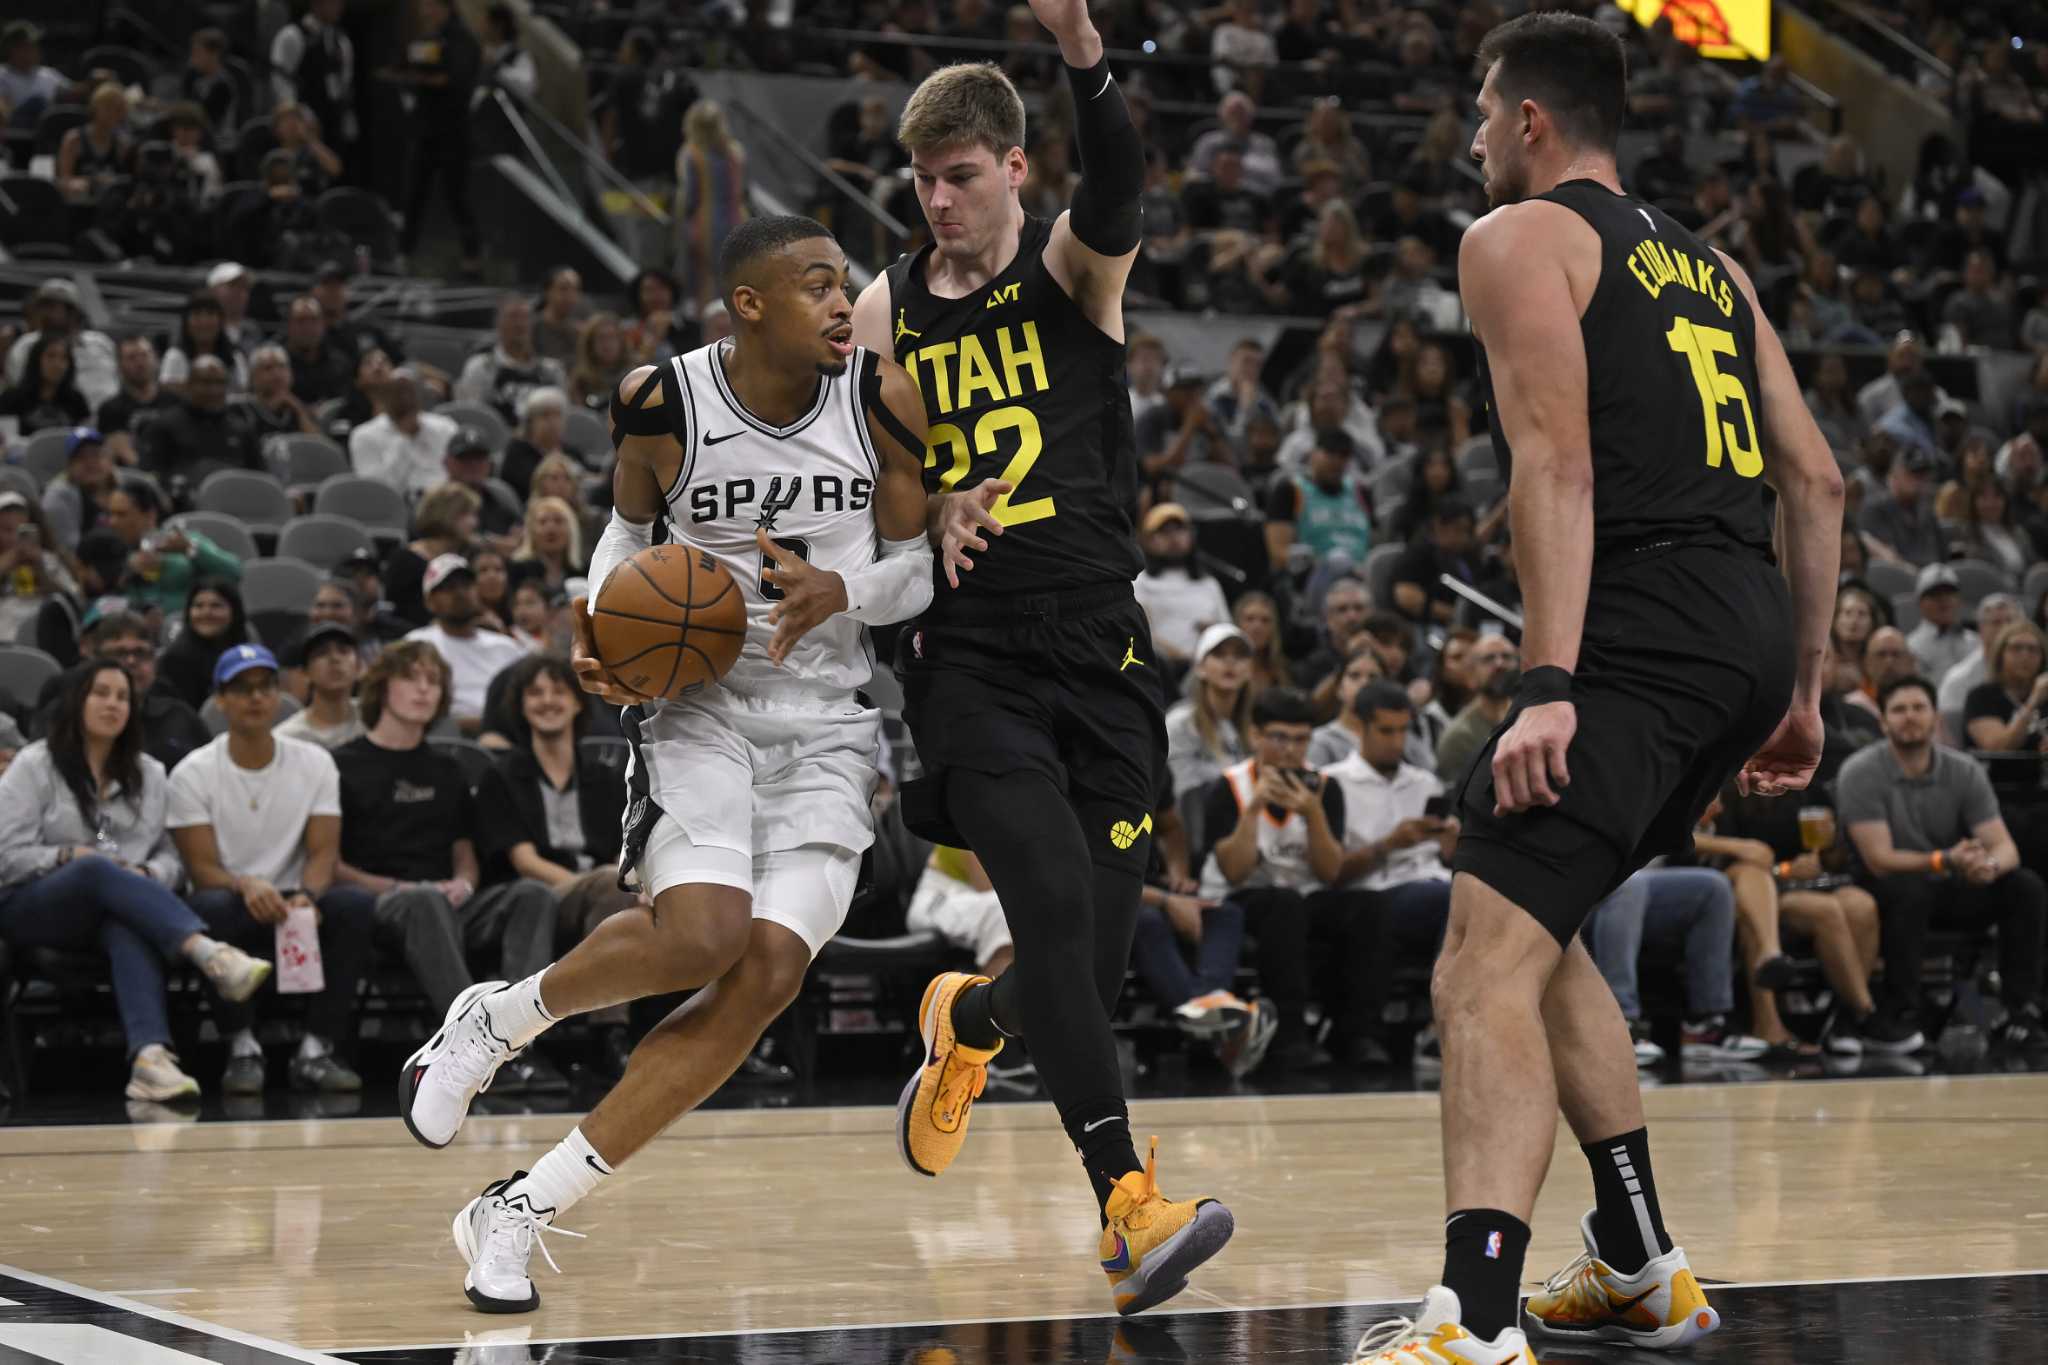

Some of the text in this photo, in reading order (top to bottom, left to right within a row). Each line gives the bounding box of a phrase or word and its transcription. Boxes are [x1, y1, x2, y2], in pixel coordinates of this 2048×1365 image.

[1627, 239, 1733, 318] EUBANKS
[905, 320, 1050, 414] TAH
[1665, 316, 1764, 478] 15
[690, 476, 873, 530] SPURS
